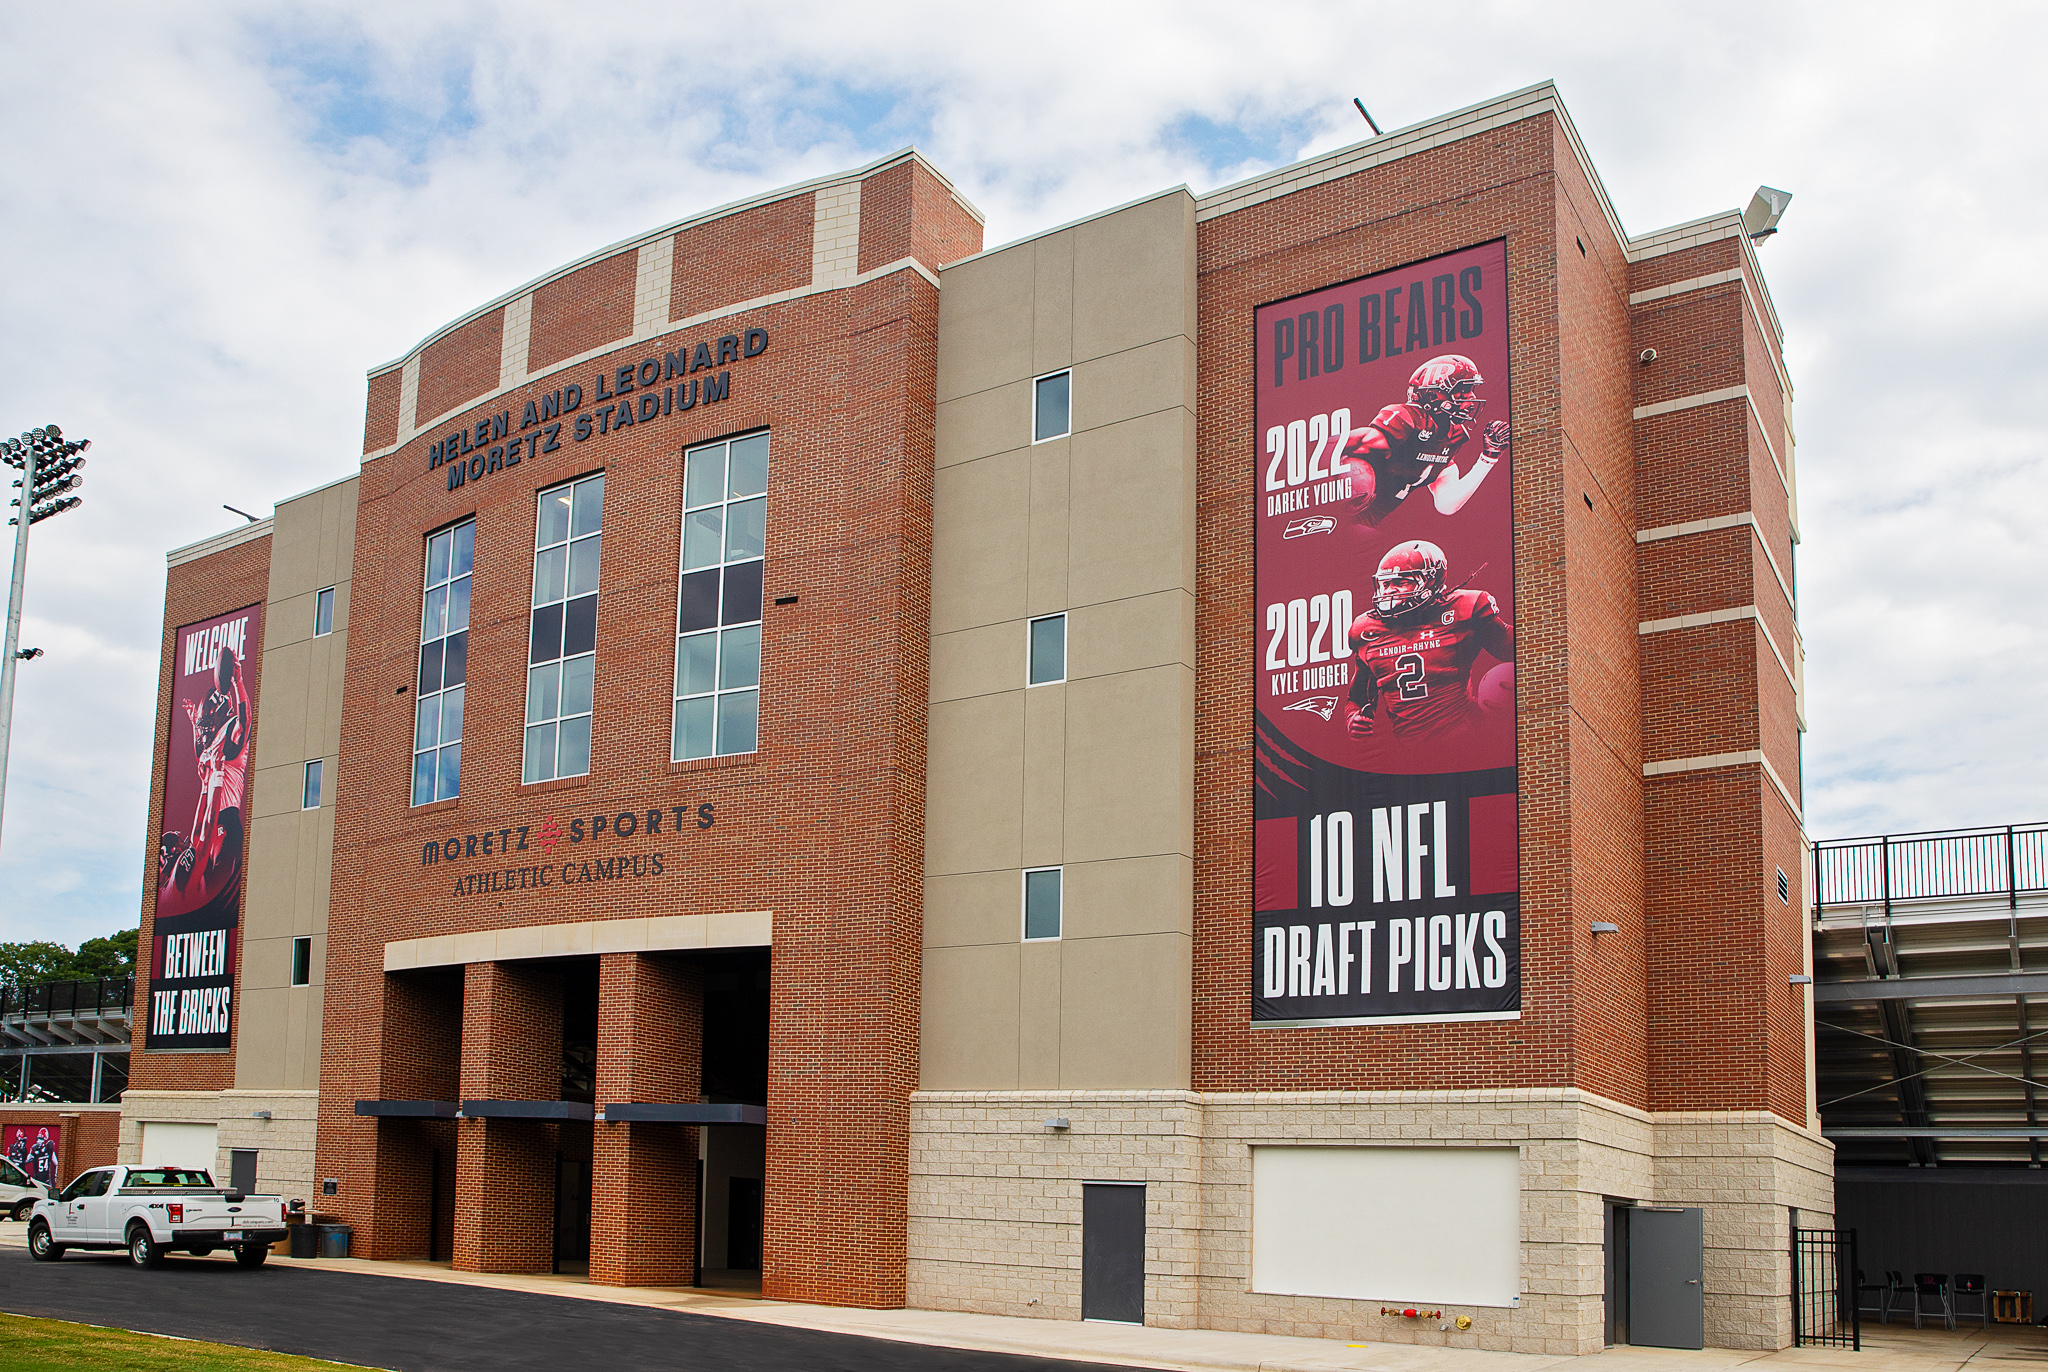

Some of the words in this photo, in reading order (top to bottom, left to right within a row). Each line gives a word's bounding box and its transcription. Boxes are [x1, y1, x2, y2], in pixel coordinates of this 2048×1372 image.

[1274, 303, 1344, 388] PRO
[1359, 266, 1483, 365] BEARS
[428, 411, 508, 470] HELEN
[520, 383, 582, 429] AND
[596, 328, 768, 401] LEONARD
[447, 423, 561, 490] MORETZ
[573, 371, 730, 442] STADIUM
[1265, 408, 1351, 492] 2022
[1267, 490, 1309, 517] DAREKE
[1313, 477, 1352, 505] YOUNG
[184, 616, 249, 677] WELCOME
[1265, 590, 1353, 671] 2020
[1379, 639, 1441, 657] LENOIR-RHYNE
[1271, 675, 1299, 696] KYLE
[1302, 662, 1349, 691] DUGGER
[1395, 652, 1428, 701] 2
[422, 825, 530, 865] MORETZ
[569, 802, 715, 843] SPORTS
[1310, 811, 1354, 908] 10
[1372, 800, 1456, 904] NFL
[453, 865, 553, 897] ATHLETIC
[562, 853, 664, 884] CAMPUS
[165, 929, 226, 978] BETWEEN
[1263, 920, 1376, 999] DRAFT
[1388, 910, 1507, 993] PICKS
[153, 990, 178, 1035] THE
[178, 986, 231, 1035] BRICKS
[38, 1158, 49, 1173] 54
